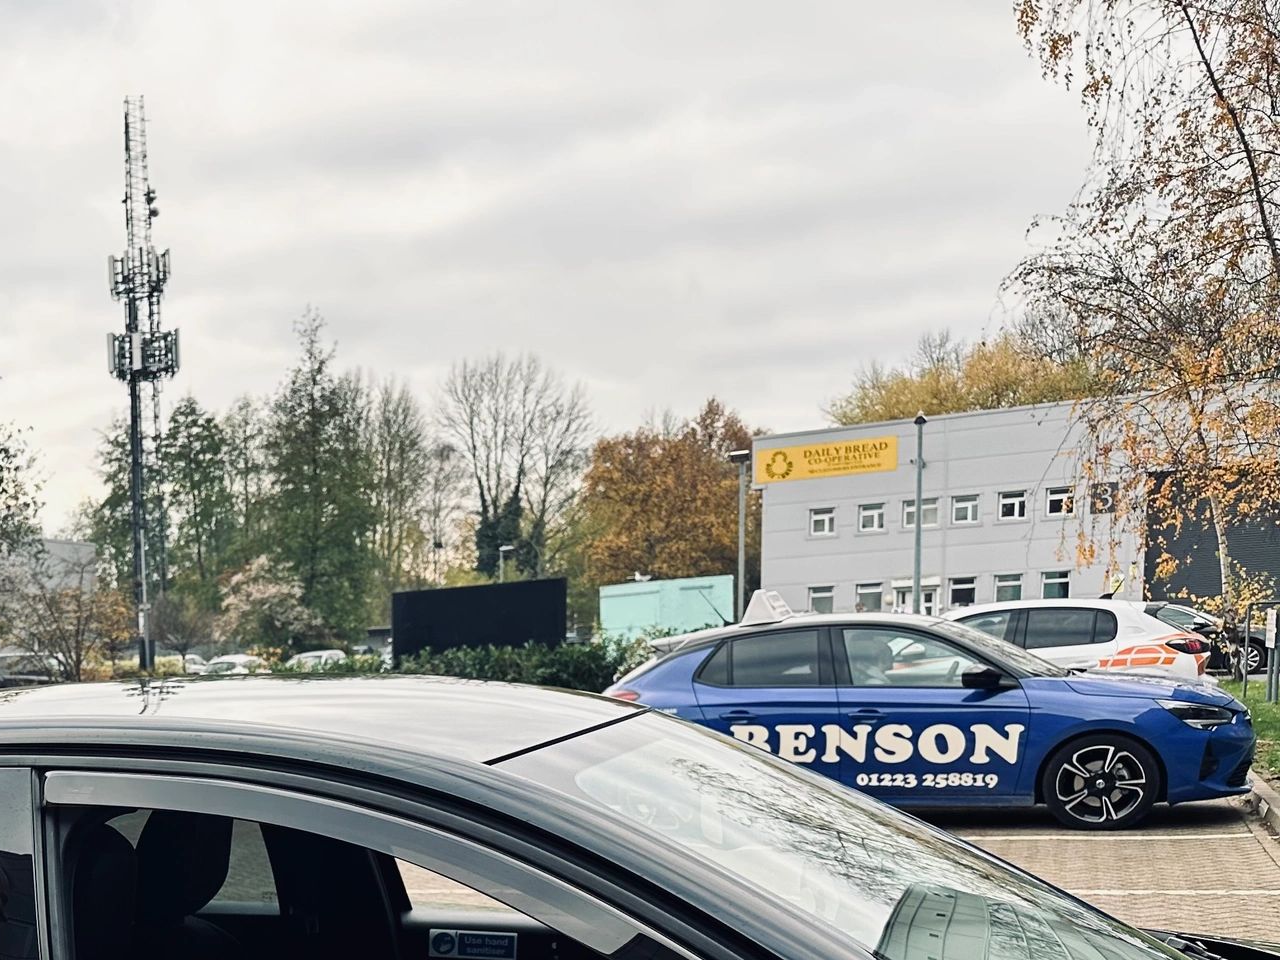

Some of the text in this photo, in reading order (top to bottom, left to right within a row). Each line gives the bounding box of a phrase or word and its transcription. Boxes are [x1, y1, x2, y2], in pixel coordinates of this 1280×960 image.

[803, 441, 888, 459] DAILY BREAD
[807, 452, 881, 466] CO-OPERATIVE
[730, 723, 1025, 764] BENSON
[856, 772, 999, 789] 01223 258819
[464, 936, 508, 946] Use hand
